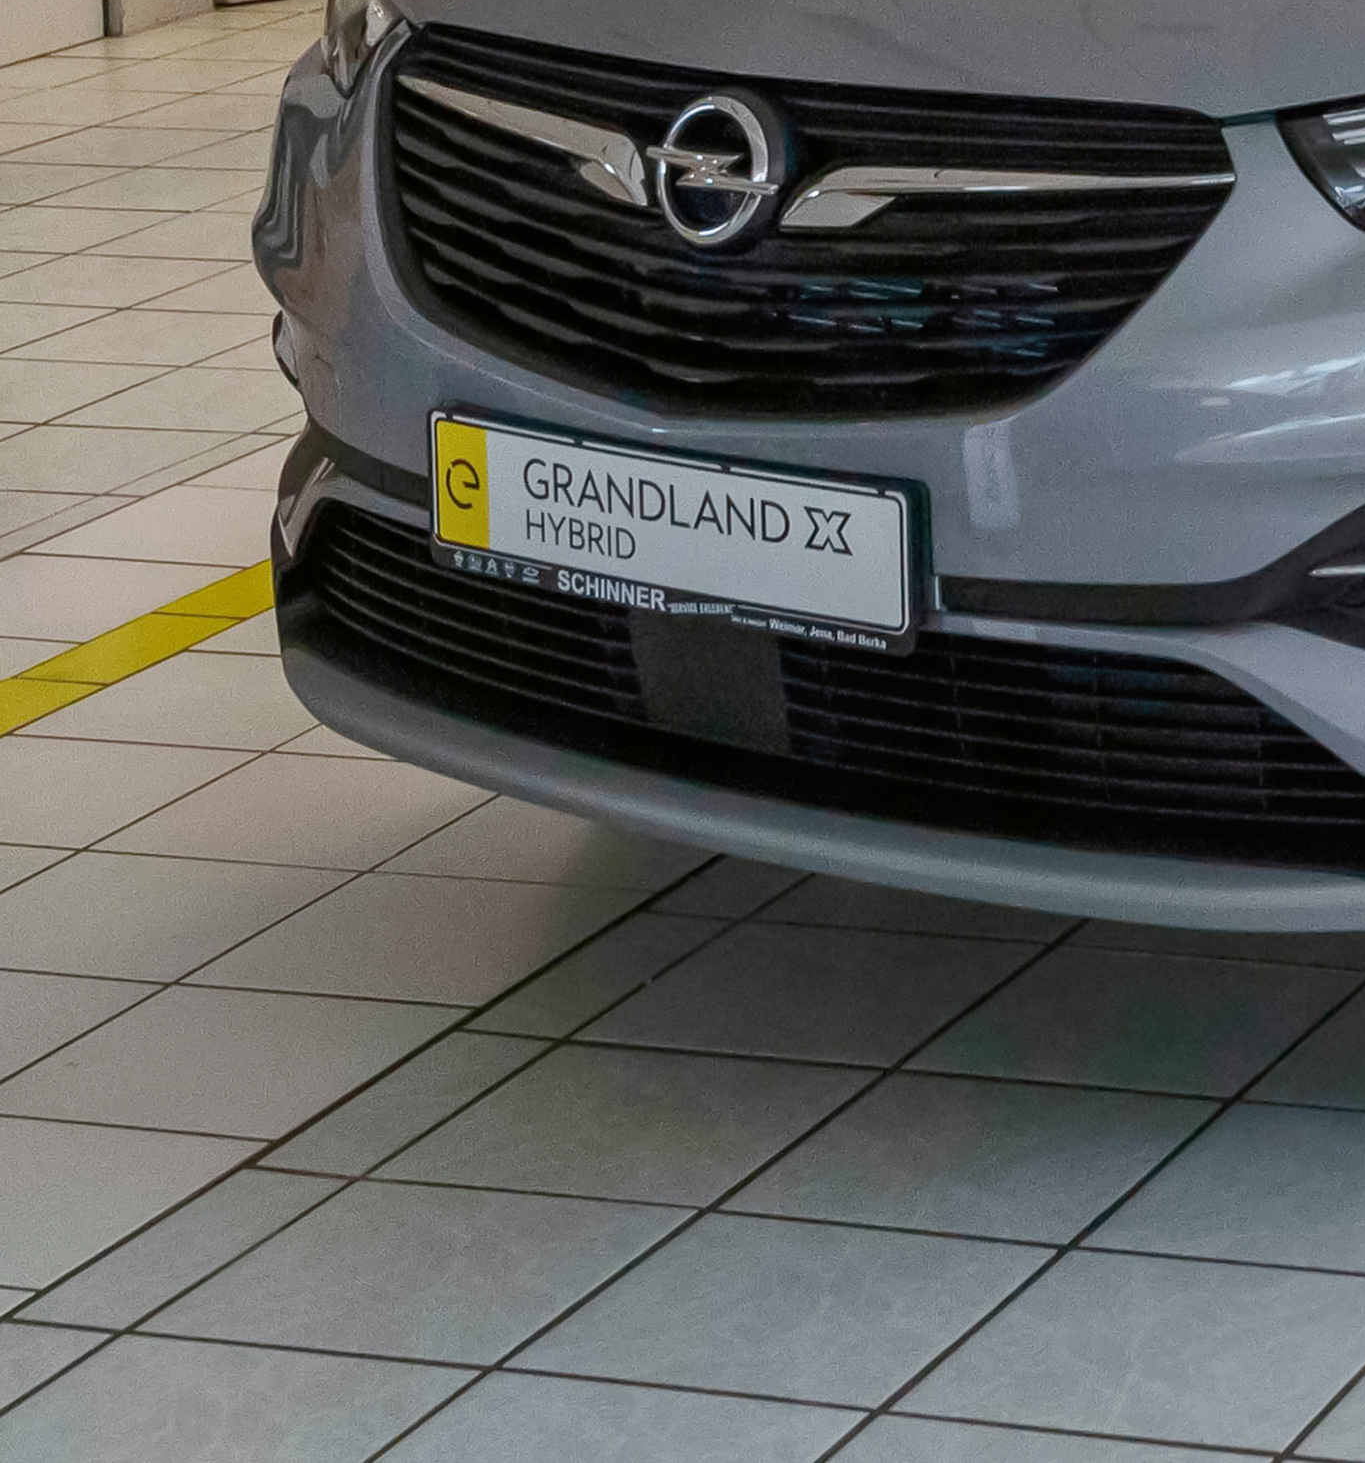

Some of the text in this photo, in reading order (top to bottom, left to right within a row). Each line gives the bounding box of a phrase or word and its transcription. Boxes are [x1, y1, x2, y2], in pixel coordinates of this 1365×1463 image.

[523, 457, 853, 557] GRANDLAND X
[526, 508, 636, 560] HYBRID
[557, 569, 667, 612] SCHINNER
